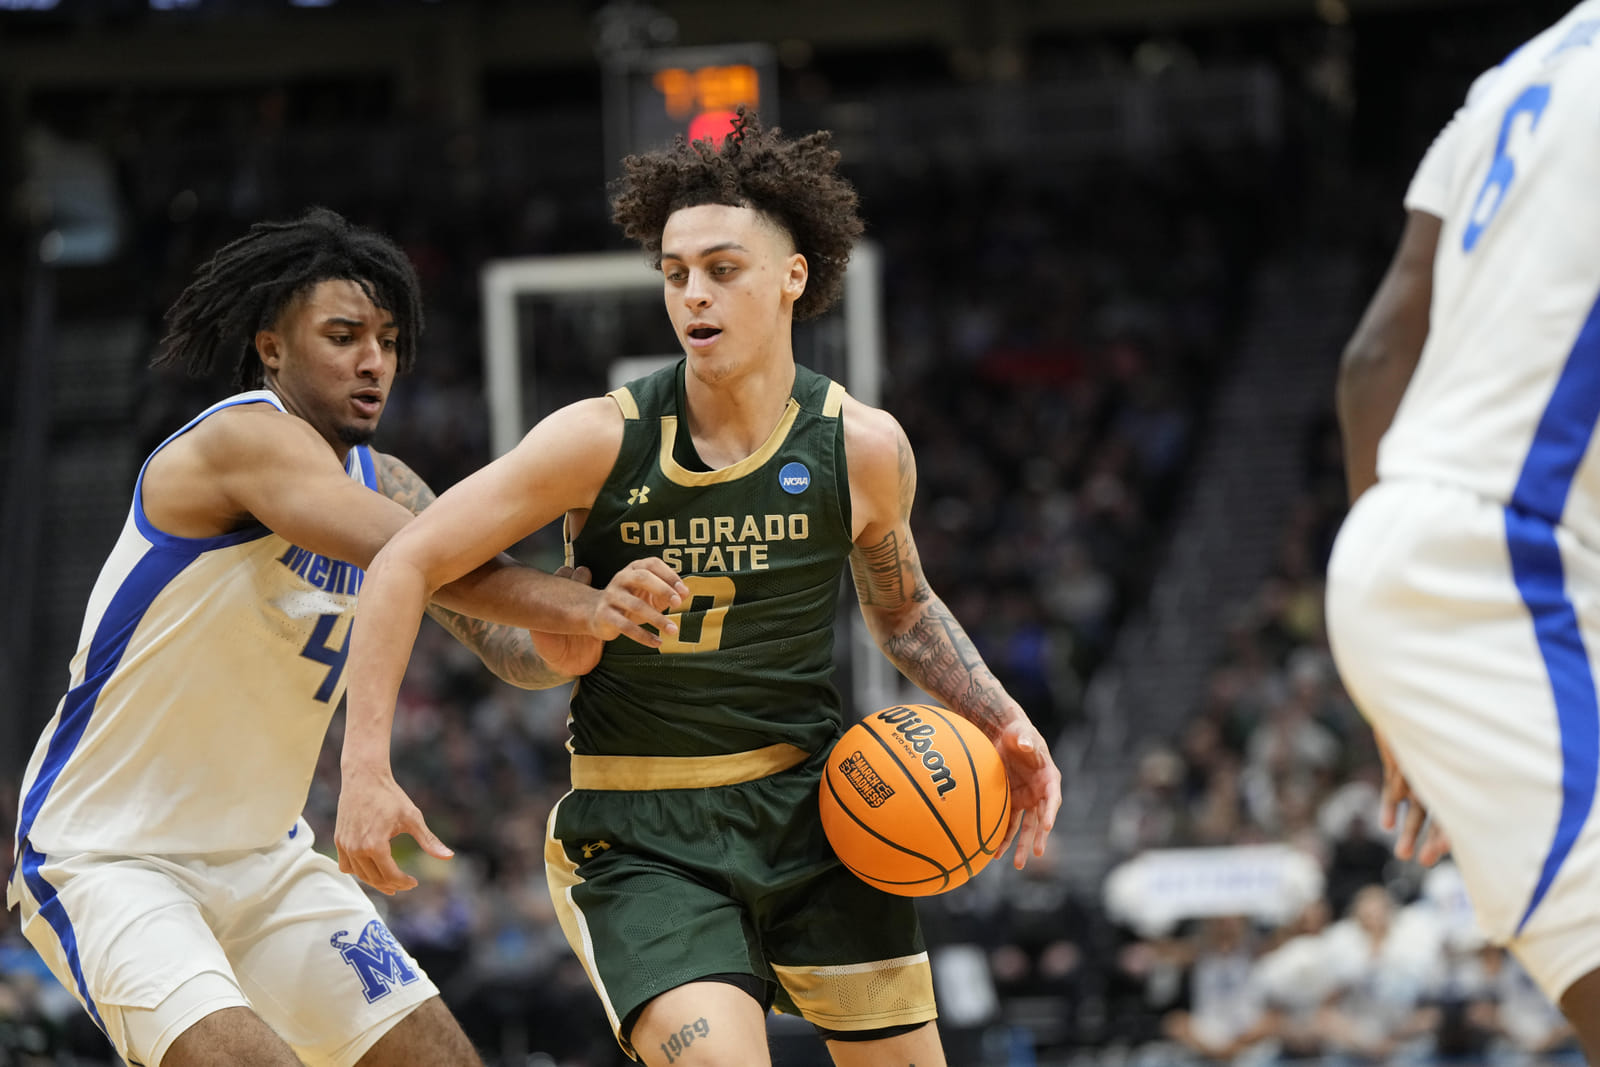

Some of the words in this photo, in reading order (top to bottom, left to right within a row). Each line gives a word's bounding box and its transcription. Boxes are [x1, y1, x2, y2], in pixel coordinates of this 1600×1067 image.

[1462, 82, 1551, 254] 6
[783, 477, 808, 486] NCAA
[620, 513, 809, 546] COLORADO
[662, 544, 769, 573] STATE
[658, 576, 737, 654] 0
[299, 613, 356, 704] 4
[855, 758, 881, 787] MARCH
[877, 706, 957, 798] Wilson
[849, 768, 885, 807] MADNESS
[660, 1016, 711, 1065] 1969
